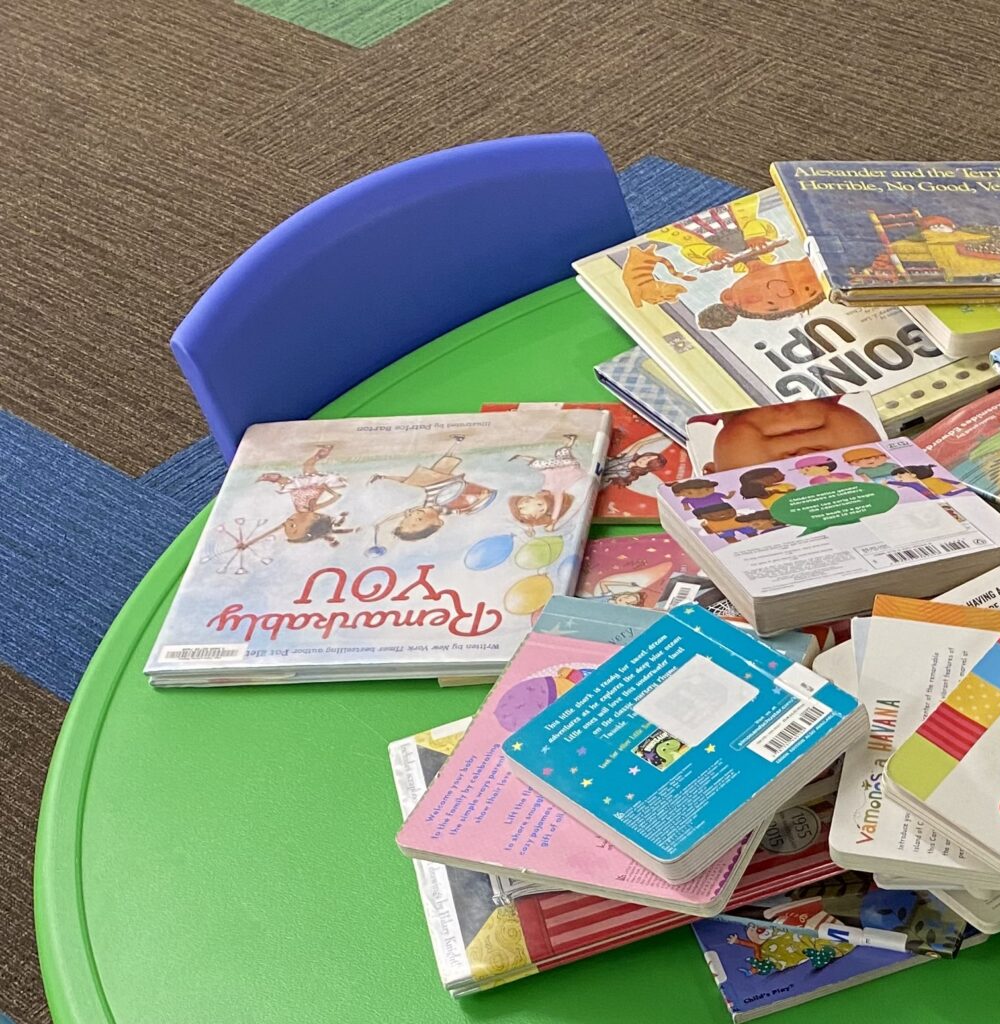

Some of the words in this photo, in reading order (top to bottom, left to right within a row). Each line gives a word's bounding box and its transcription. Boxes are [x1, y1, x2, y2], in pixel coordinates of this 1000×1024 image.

[794, 166, 886, 178] Alexander
[891, 168, 925, 178] and
[927, 168, 955, 178] the
[798, 180, 884, 192] Horrible,
[883, 182, 914, 191] No
[918, 182, 976, 193] Good,
[754, 318, 856, 372] UP!
[775, 324, 944, 397] GOING
[293, 564, 439, 604] YOU
[967, 591, 996, 607] HAVING
[206, 589, 502, 640] Remarkably
[245, 648, 268, 657] Ziet
[270, 648, 290, 656] Pat
[291, 647, 324, 655] author
[465, 643, 499, 651] Written
[867, 700, 900, 751] HAVANA
[875, 759, 888, 768] a
[425, 790, 453, 823] Welcome
[452, 774, 464, 790] your
[460, 755, 477, 772] baby
[856, 773, 883, 844] Vámonos
[794, 813, 812, 838] 1955
[744, 991, 771, 1004] Child's
